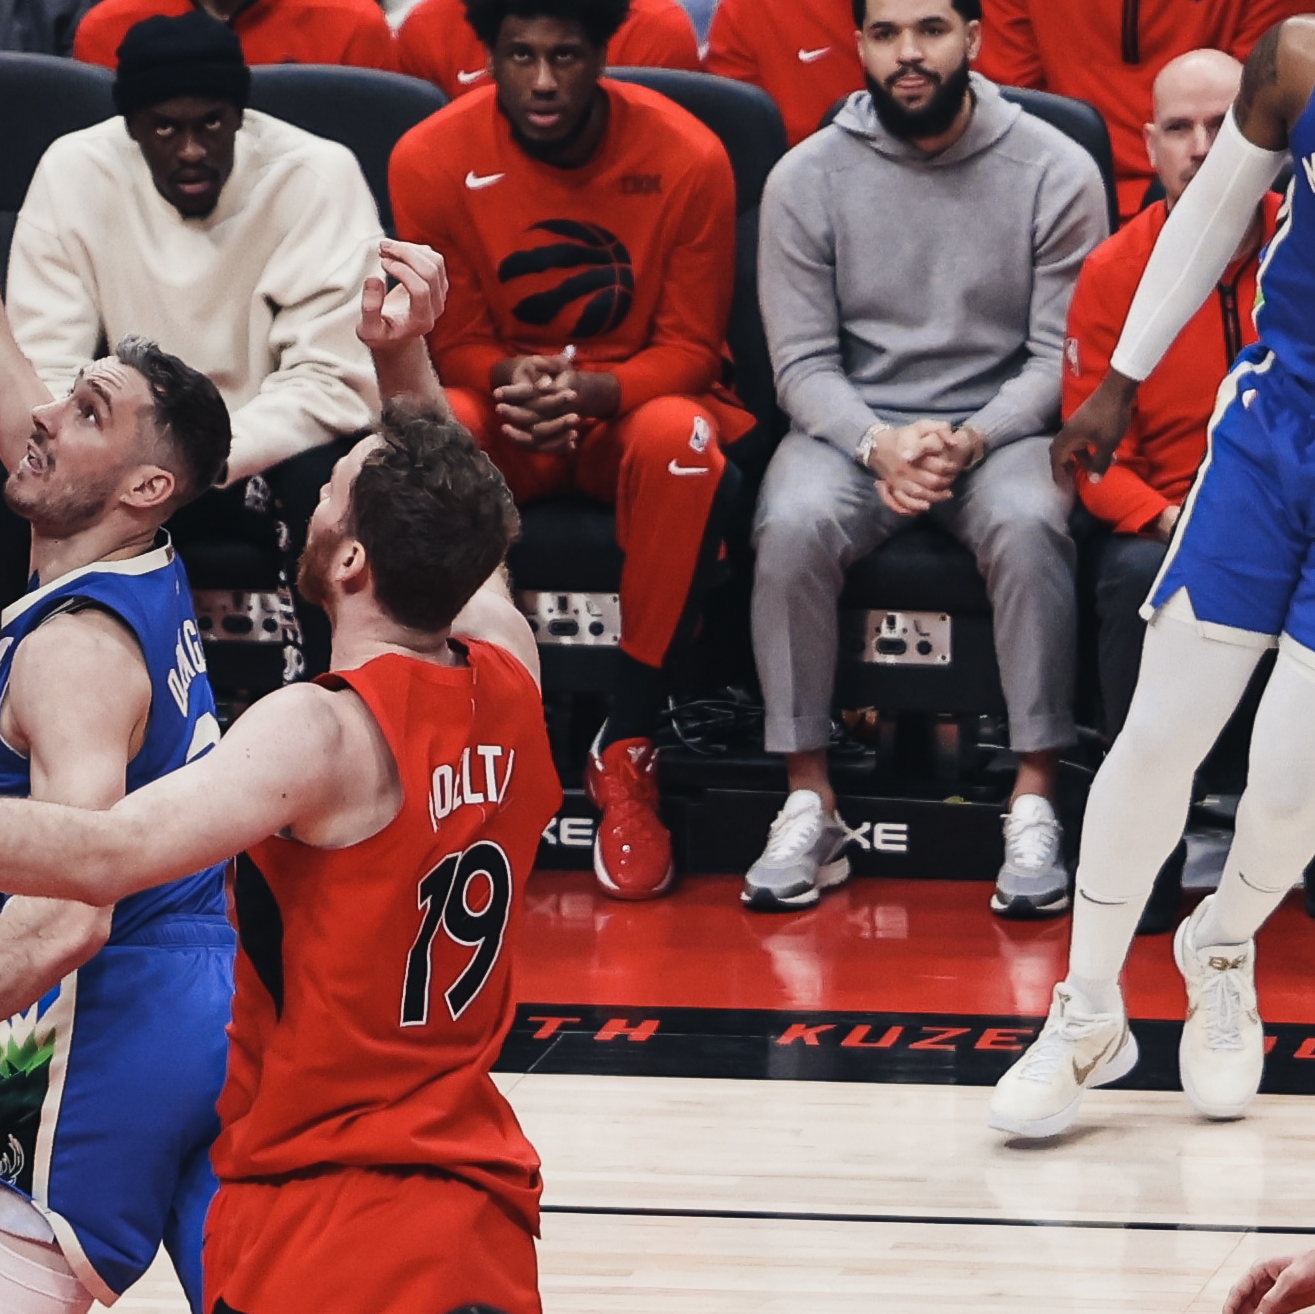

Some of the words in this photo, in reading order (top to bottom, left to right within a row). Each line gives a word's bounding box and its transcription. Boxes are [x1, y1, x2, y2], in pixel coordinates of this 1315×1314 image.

[846, 821, 908, 852] XE
[399, 839, 513, 1028] 19
[773, 1023, 1035, 1053] KUZE
